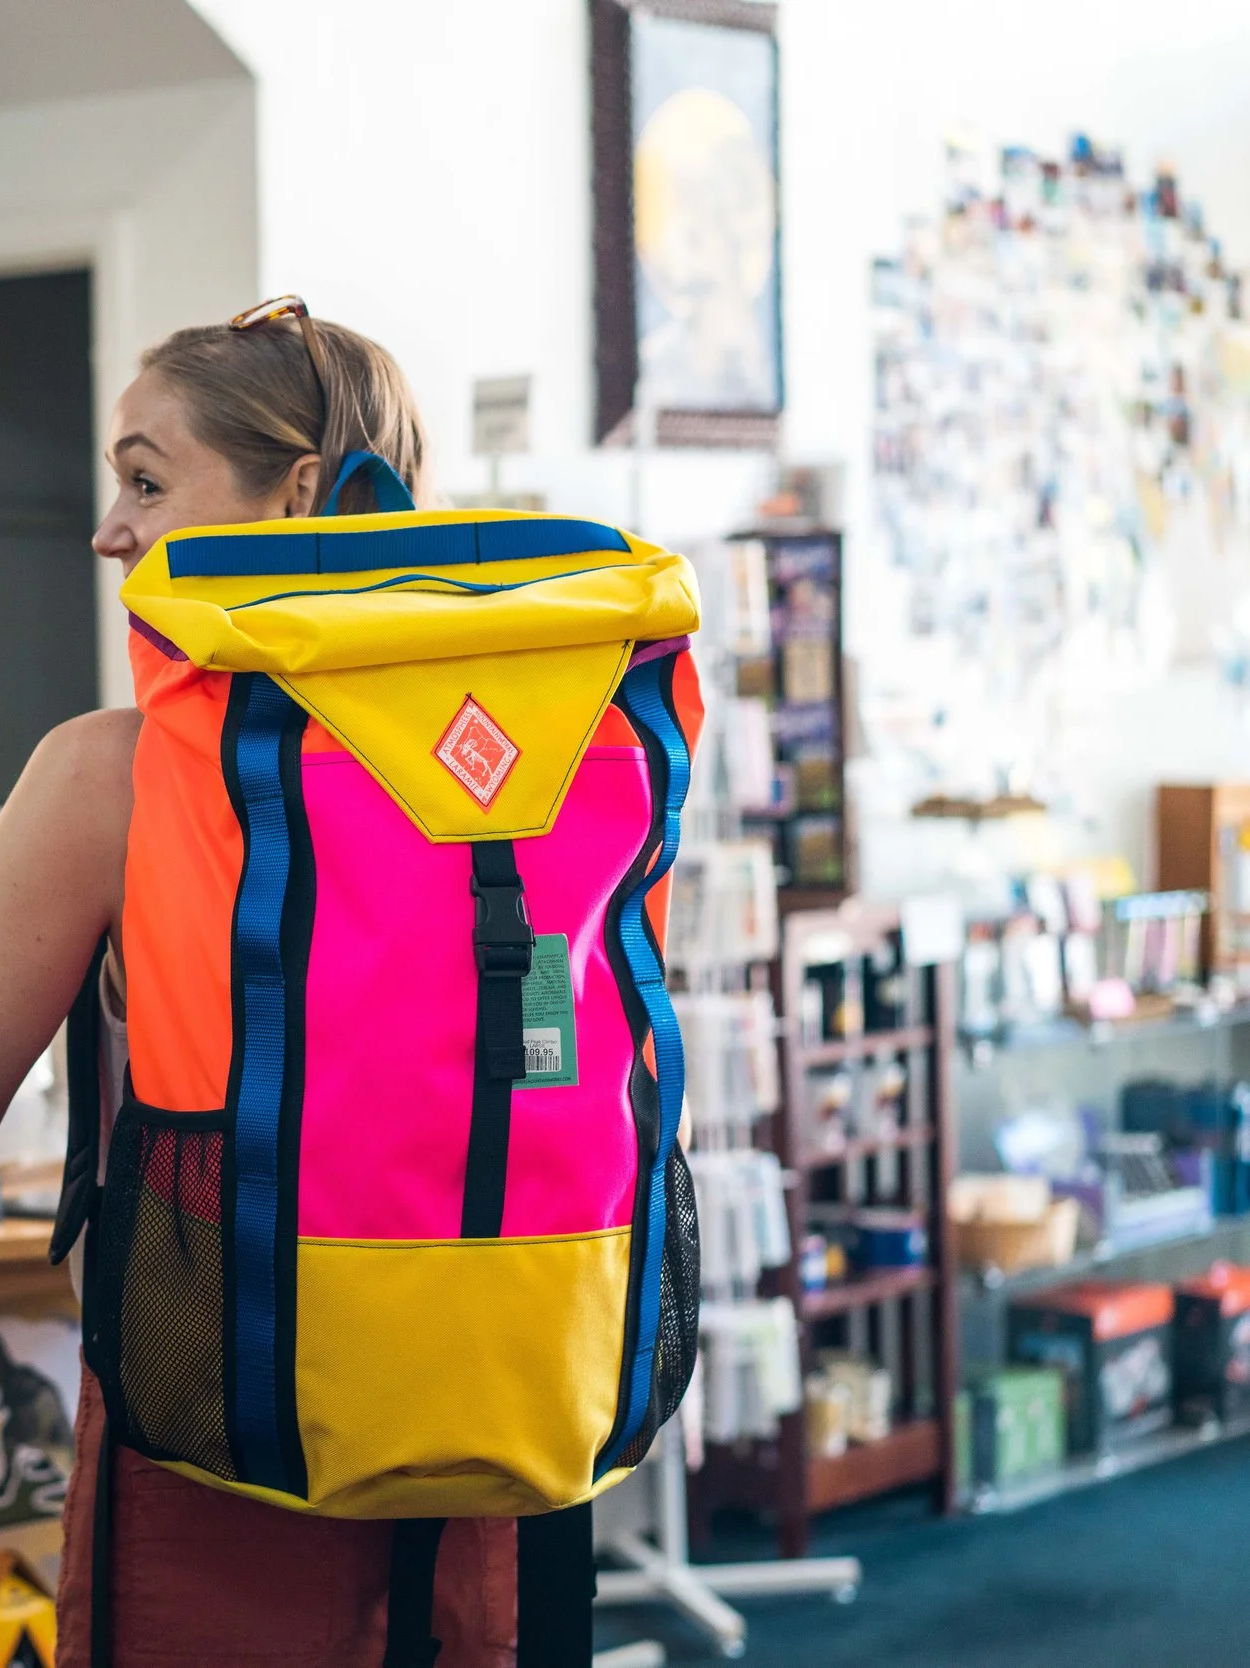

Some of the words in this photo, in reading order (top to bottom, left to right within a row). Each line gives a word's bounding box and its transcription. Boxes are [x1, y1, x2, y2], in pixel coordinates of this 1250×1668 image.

[443, 711, 473, 754] ATMOSPHERE
[475, 710, 515, 754] MOUNTAINWORKS
[449, 760, 479, 792] LARAMIE
[485, 757, 510, 793] WYOMING
